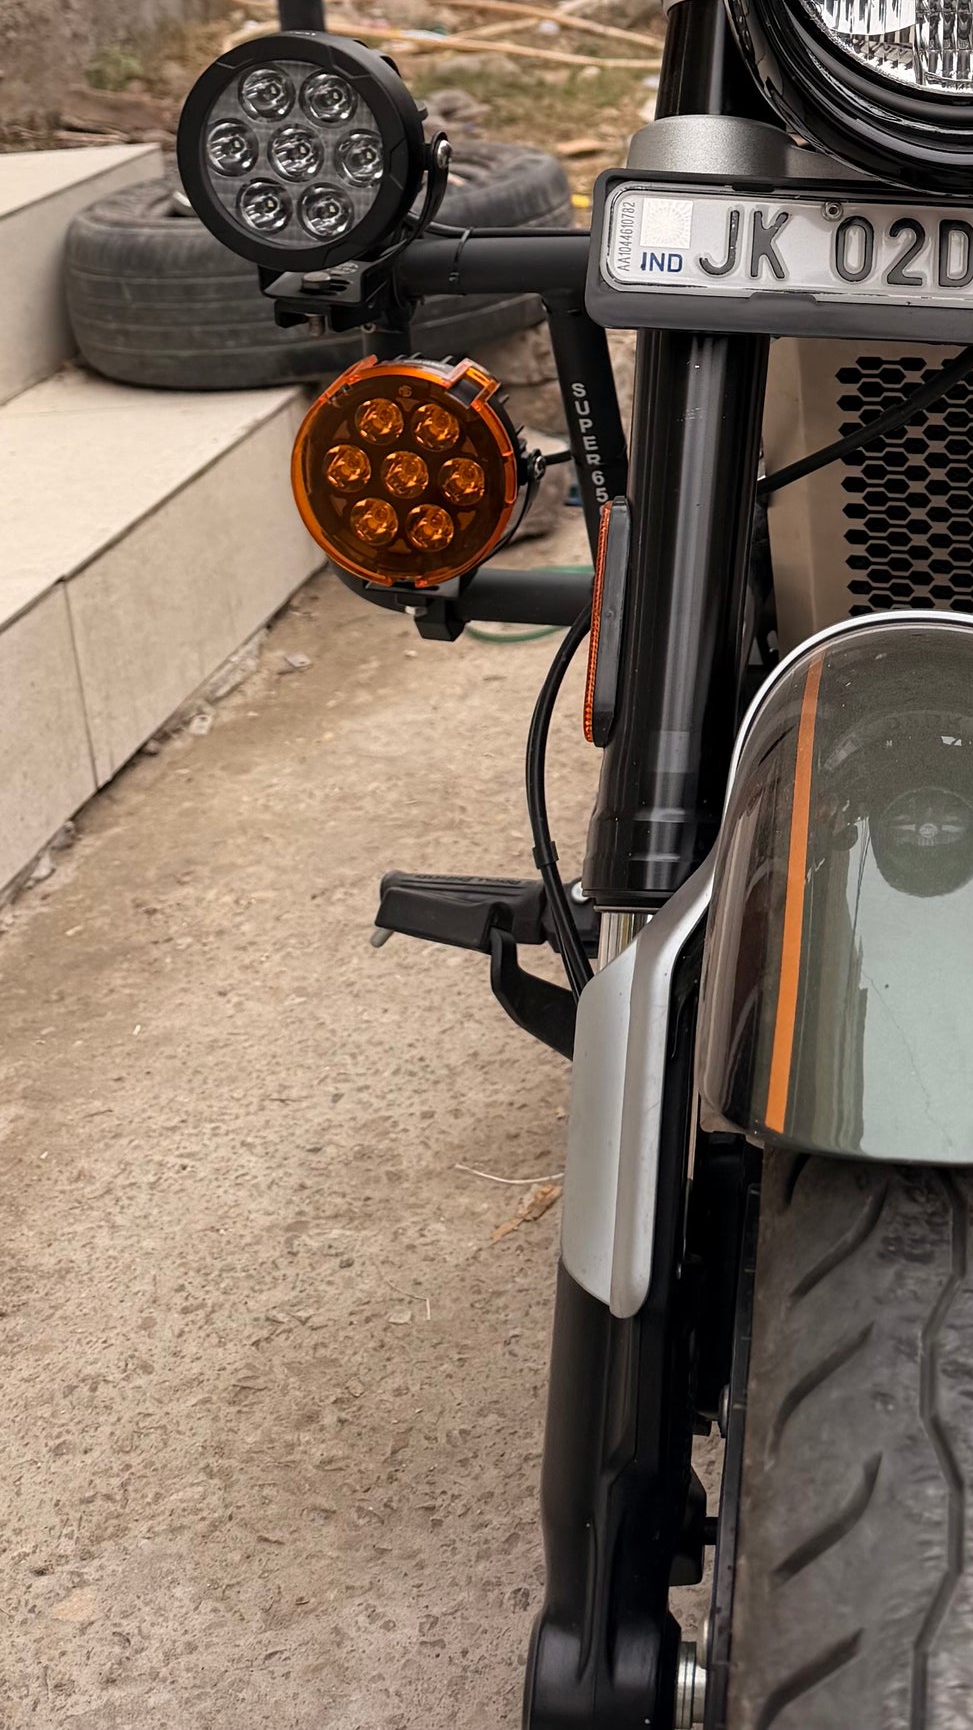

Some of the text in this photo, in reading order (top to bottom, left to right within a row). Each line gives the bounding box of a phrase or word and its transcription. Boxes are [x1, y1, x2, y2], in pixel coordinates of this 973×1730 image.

[640, 251, 683, 273] IND
[699, 209, 790, 279] JK
[571, 382, 609, 513] SUPER65
